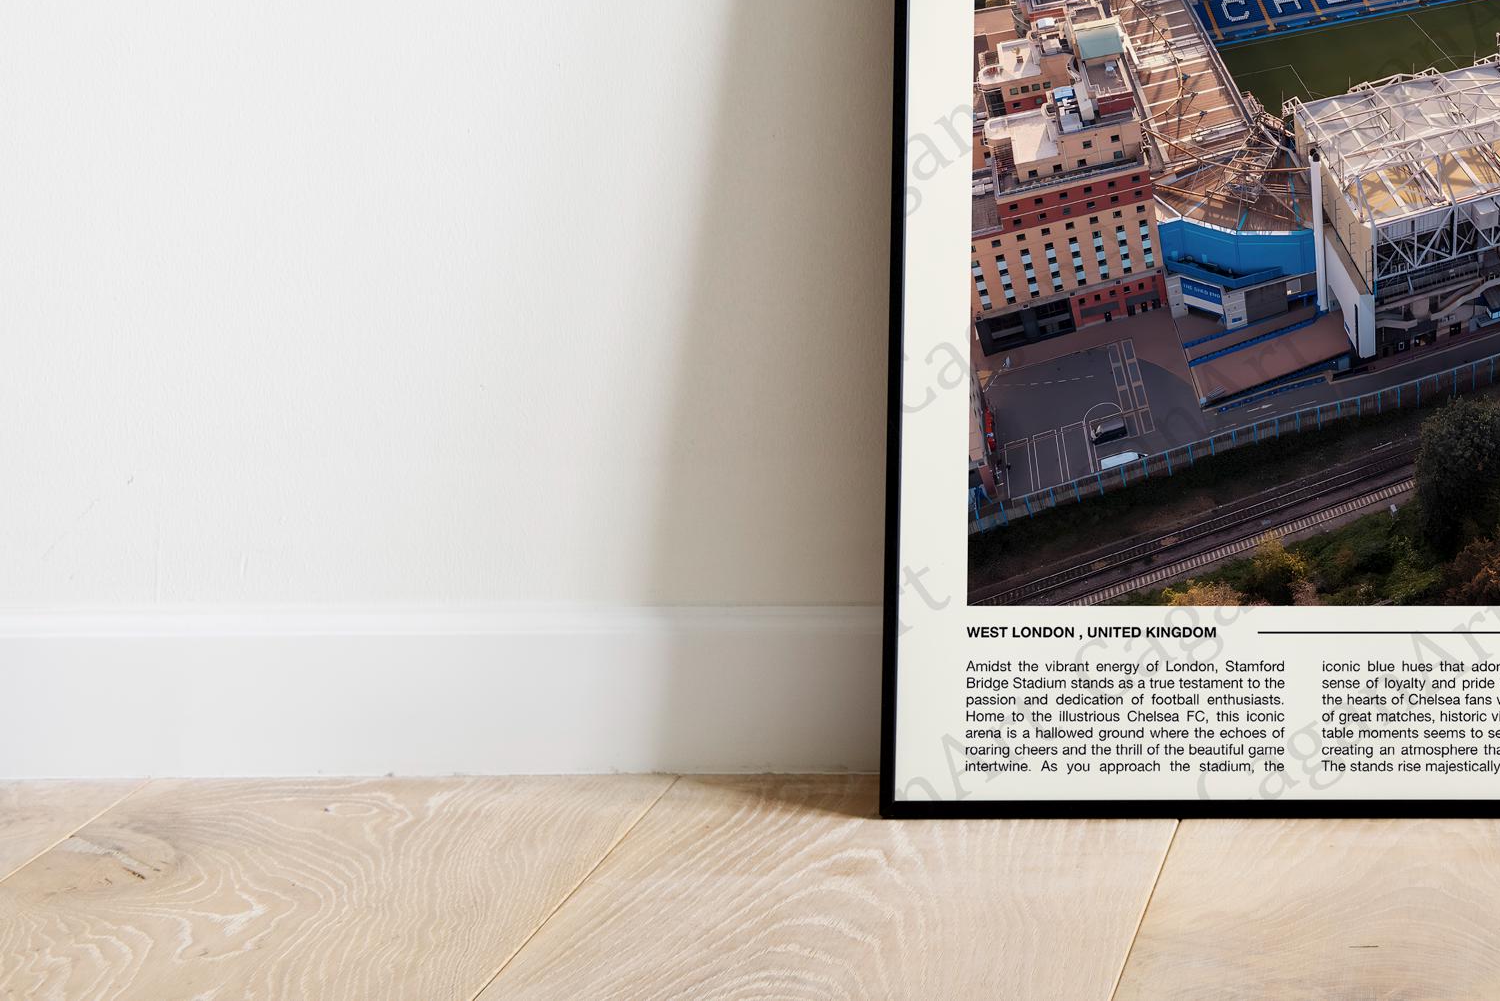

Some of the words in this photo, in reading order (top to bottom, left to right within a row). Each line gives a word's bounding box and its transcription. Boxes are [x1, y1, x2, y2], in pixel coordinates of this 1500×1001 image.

[966, 626, 1009, 639] WEST
[1012, 626, 1075, 639] LONDON
[1087, 626, 1142, 639] UNITED
[1145, 626, 1217, 639] KINGDOM
[965, 660, 1012, 672] Amidst
[1017, 660, 1039, 673] the
[1044, 660, 1090, 673] vibrant
[1095, 662, 1140, 676] energy
[1145, 660, 1160, 673] of
[1165, 660, 1218, 674] London,
[1225, 659, 1285, 673] Stamford
[1322, 660, 1361, 673] iconic
[1367, 660, 1395, 673] blue
[1401, 660, 1433, 673] hues
[1439, 660, 1465, 673] that
[966, 676, 1009, 692] Bridge
[1012, 676, 1067, 689] Stadium
[1070, 676, 1115, 690] stands
[1118, 679, 1134, 689] as
[1137, 679, 1146, 689] a
[1149, 677, 1175, 689] true
[1178, 677, 1244, 689] testament
[1247, 677, 1261, 689] to
[1264, 677, 1286, 689] the
[965, 693, 1017, 708] passion
[1023, 693, 1048, 706] and
[1055, 693, 1124, 706] dedication
[1131, 693, 1145, 706] of
[1151, 693, 1200, 706] football
[1206, 693, 1284, 706] enthusiasts.
[1321, 693, 1343, 706] the
[1346, 693, 1387, 706] hearts
[1390, 693, 1405, 706] of
[1408, 693, 1461, 706] Chelsea
[1464, 693, 1493, 706] fans
[965, 710, 1005, 723] Home
[1011, 710, 1025, 723] to
[1031, 710, 1053, 723] the
[1059, 710, 1121, 723] illustrious
[1127, 710, 1180, 723] Chelsea
[1186, 710, 1209, 724] FC,
[1216, 710, 1240, 723] this
[1246, 710, 1285, 723] iconic
[1321, 710, 1335, 723] of
[1338, 711, 1372, 725] great
[1376, 710, 1436, 724] matches,
[1440, 710, 1487, 723] historic
[1321, 743, 1374, 759] creating
[1379, 746, 1395, 756] an
[1400, 743, 1478, 759] atmosphere
[965, 759, 1032, 773] intertwine.
[1040, 759, 1058, 772] As
[1066, 762, 1091, 775] you
[1099, 760, 1161, 775] approach
[1169, 760, 1191, 772] the
[1199, 760, 1255, 774] stadium,
[1263, 760, 1285, 773] the
[1320, 759, 1346, 773] The
[1350, 760, 1394, 773] stands
[1398, 760, 1422, 772] rise
